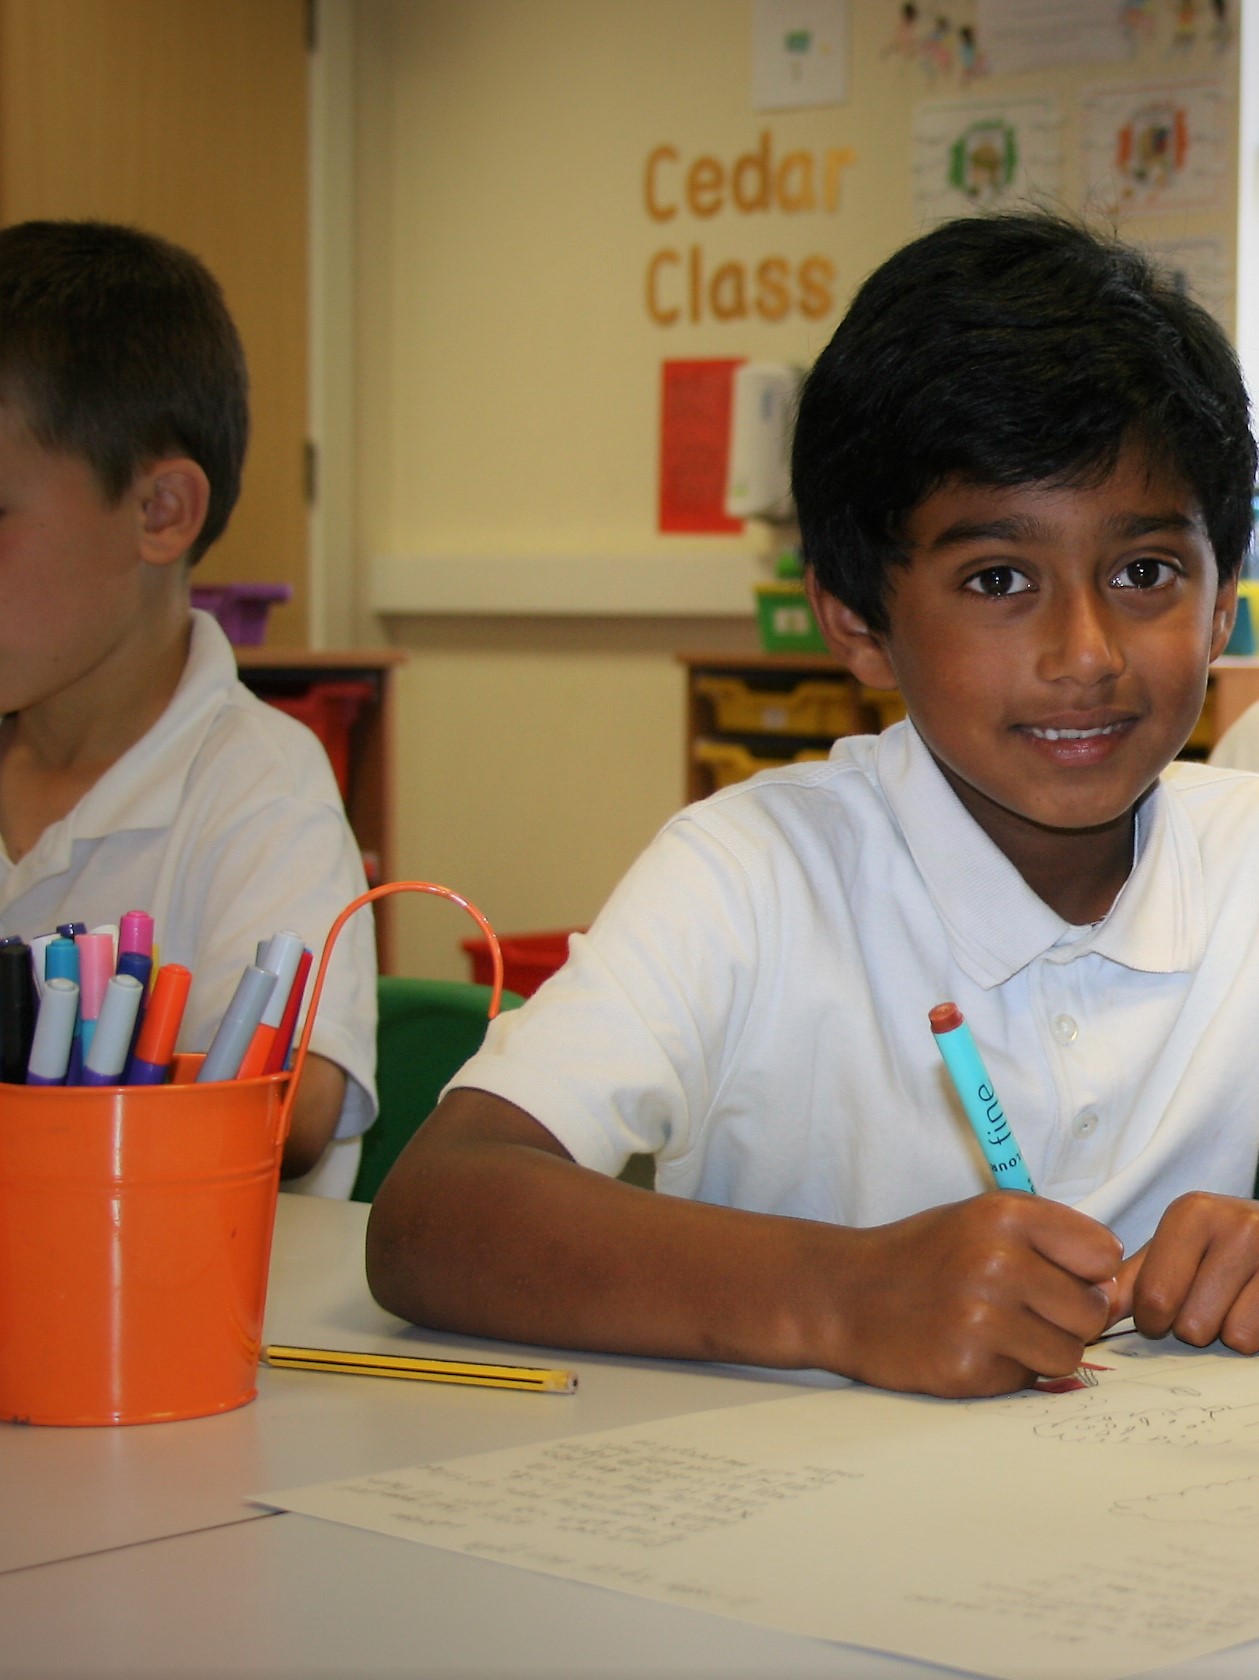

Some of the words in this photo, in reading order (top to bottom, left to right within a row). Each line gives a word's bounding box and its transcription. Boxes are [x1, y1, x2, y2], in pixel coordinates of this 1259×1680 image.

[645, 130, 856, 223] Cedar
[646, 245, 836, 327] Class
[978, 1083, 1012, 1146] fine
